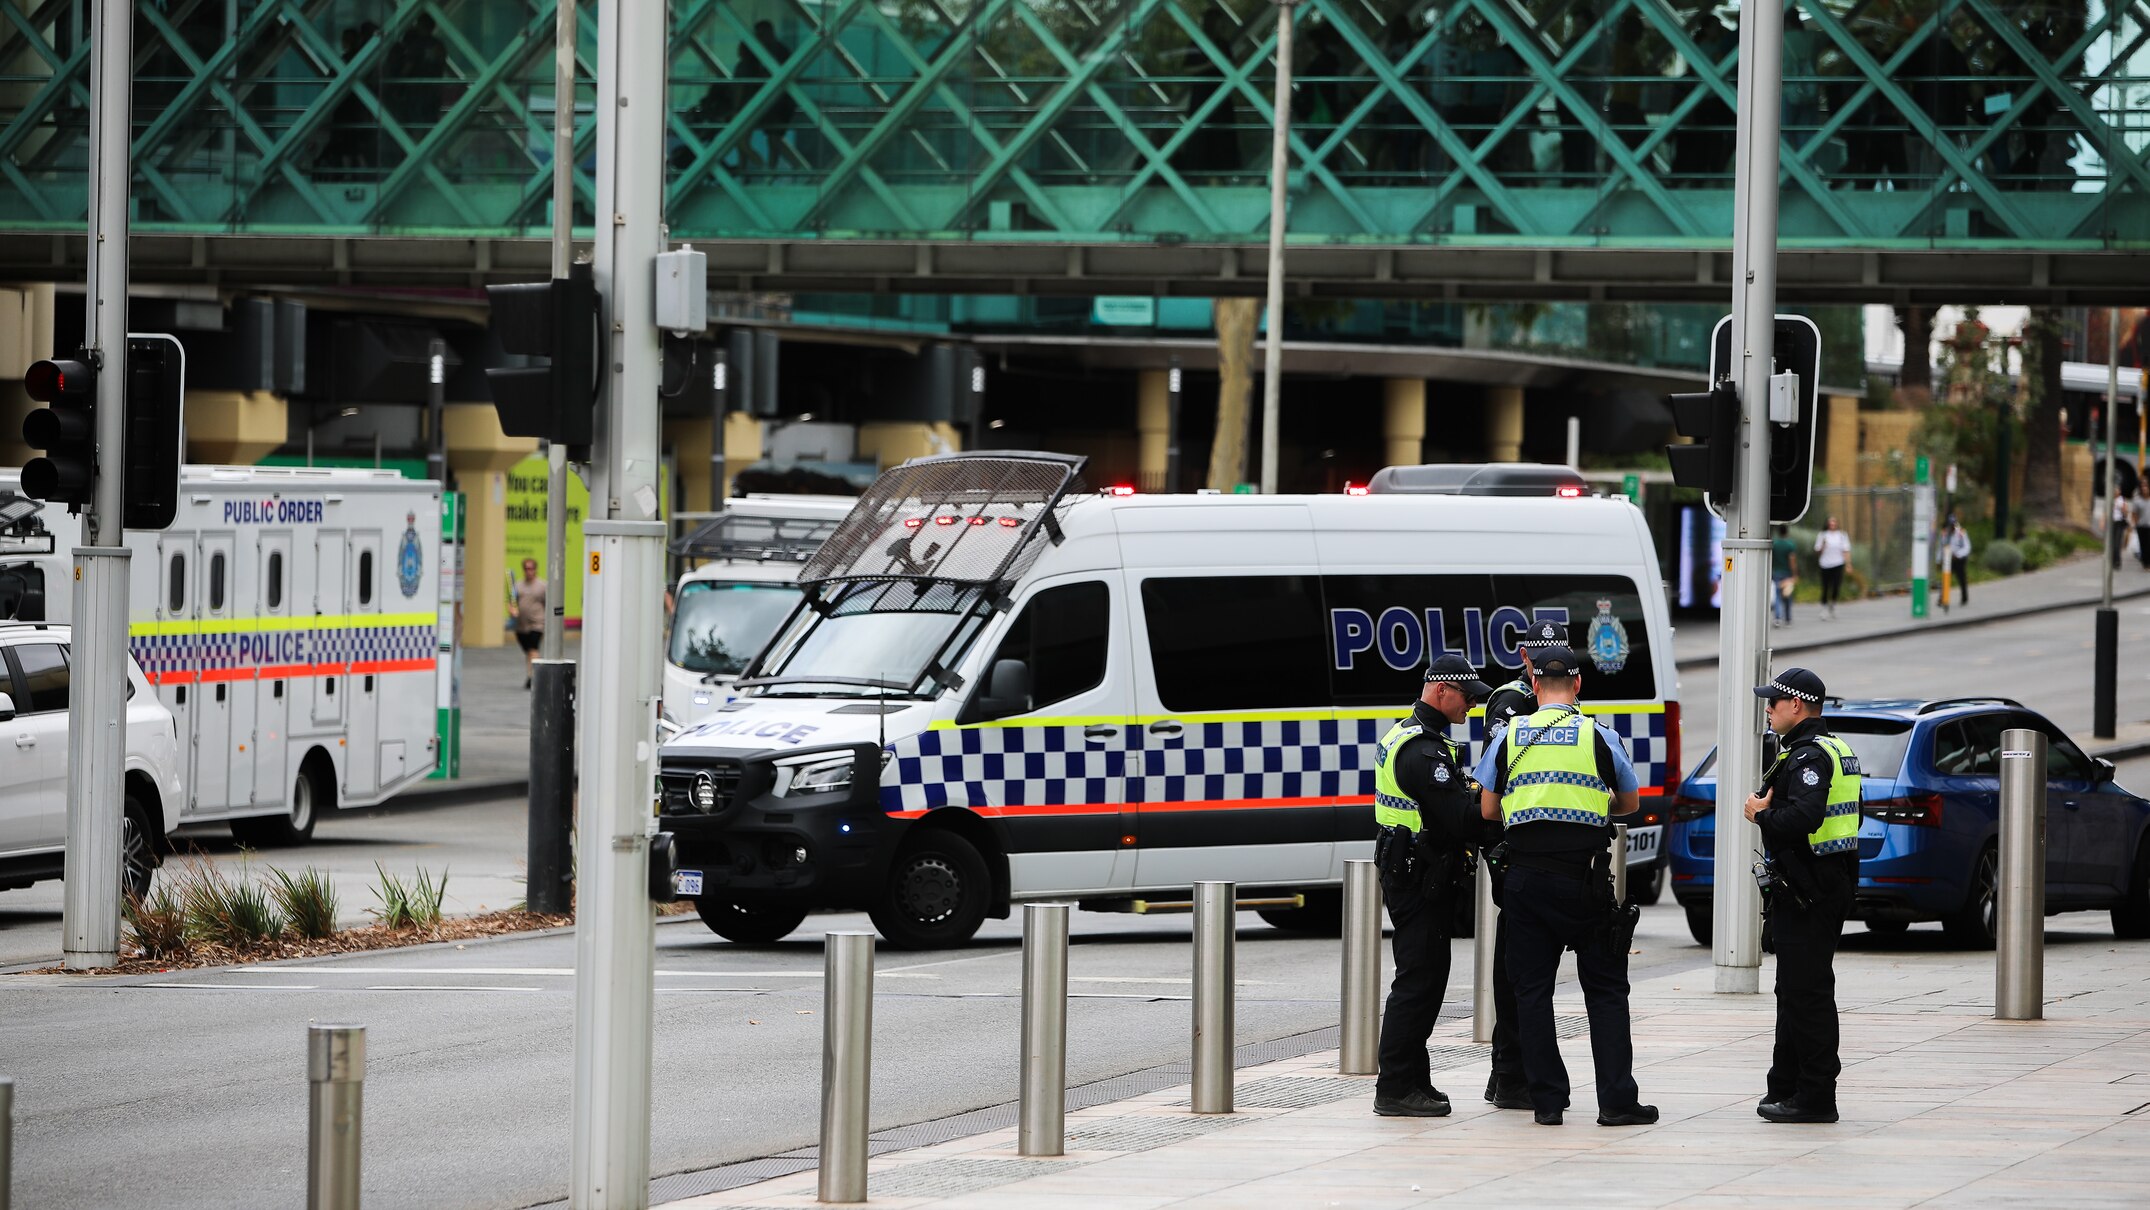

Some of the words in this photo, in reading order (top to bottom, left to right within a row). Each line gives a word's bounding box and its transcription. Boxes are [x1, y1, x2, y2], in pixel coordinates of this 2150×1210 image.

[507, 473, 528, 492] You
[224, 500, 274, 523] PUBLIC
[278, 500, 323, 523] ORDER
[506, 498, 538, 521] make
[592, 555, 600, 572] 8
[1726, 558, 1733, 570] 7
[75, 568, 81, 580] 6
[239, 632, 304, 665] POLICE
[671, 720, 820, 745] POLICE
[1518, 729, 1575, 744] POLICE
